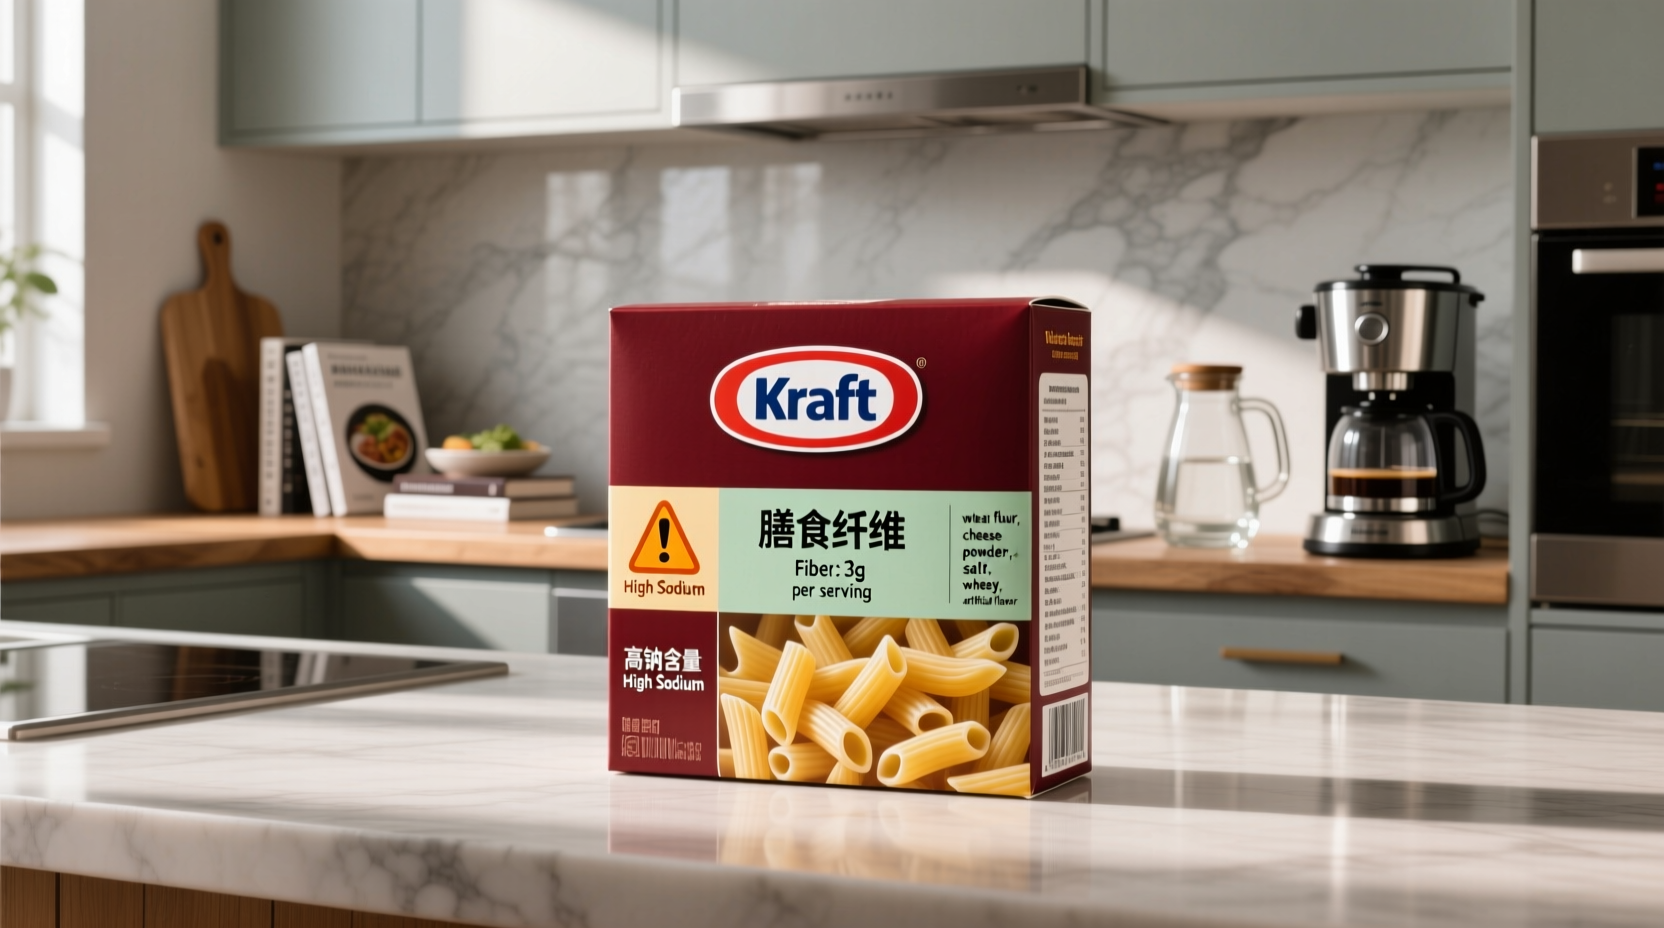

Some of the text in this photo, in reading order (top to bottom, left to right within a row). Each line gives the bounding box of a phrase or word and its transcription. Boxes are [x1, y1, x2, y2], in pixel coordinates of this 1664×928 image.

[755, 373, 877, 421] Kraft
[758, 508, 906, 551] 膳食纤维
[962, 527, 1003, 541] cheese
[963, 544, 1013, 561] powder,
[795, 559, 865, 583] Fiber: 3g
[624, 579, 705, 597] High Sodium
[792, 583, 872, 603] per serving
[623, 645, 702, 673] 高钠含量
[623, 673, 705, 692] High Sodium
